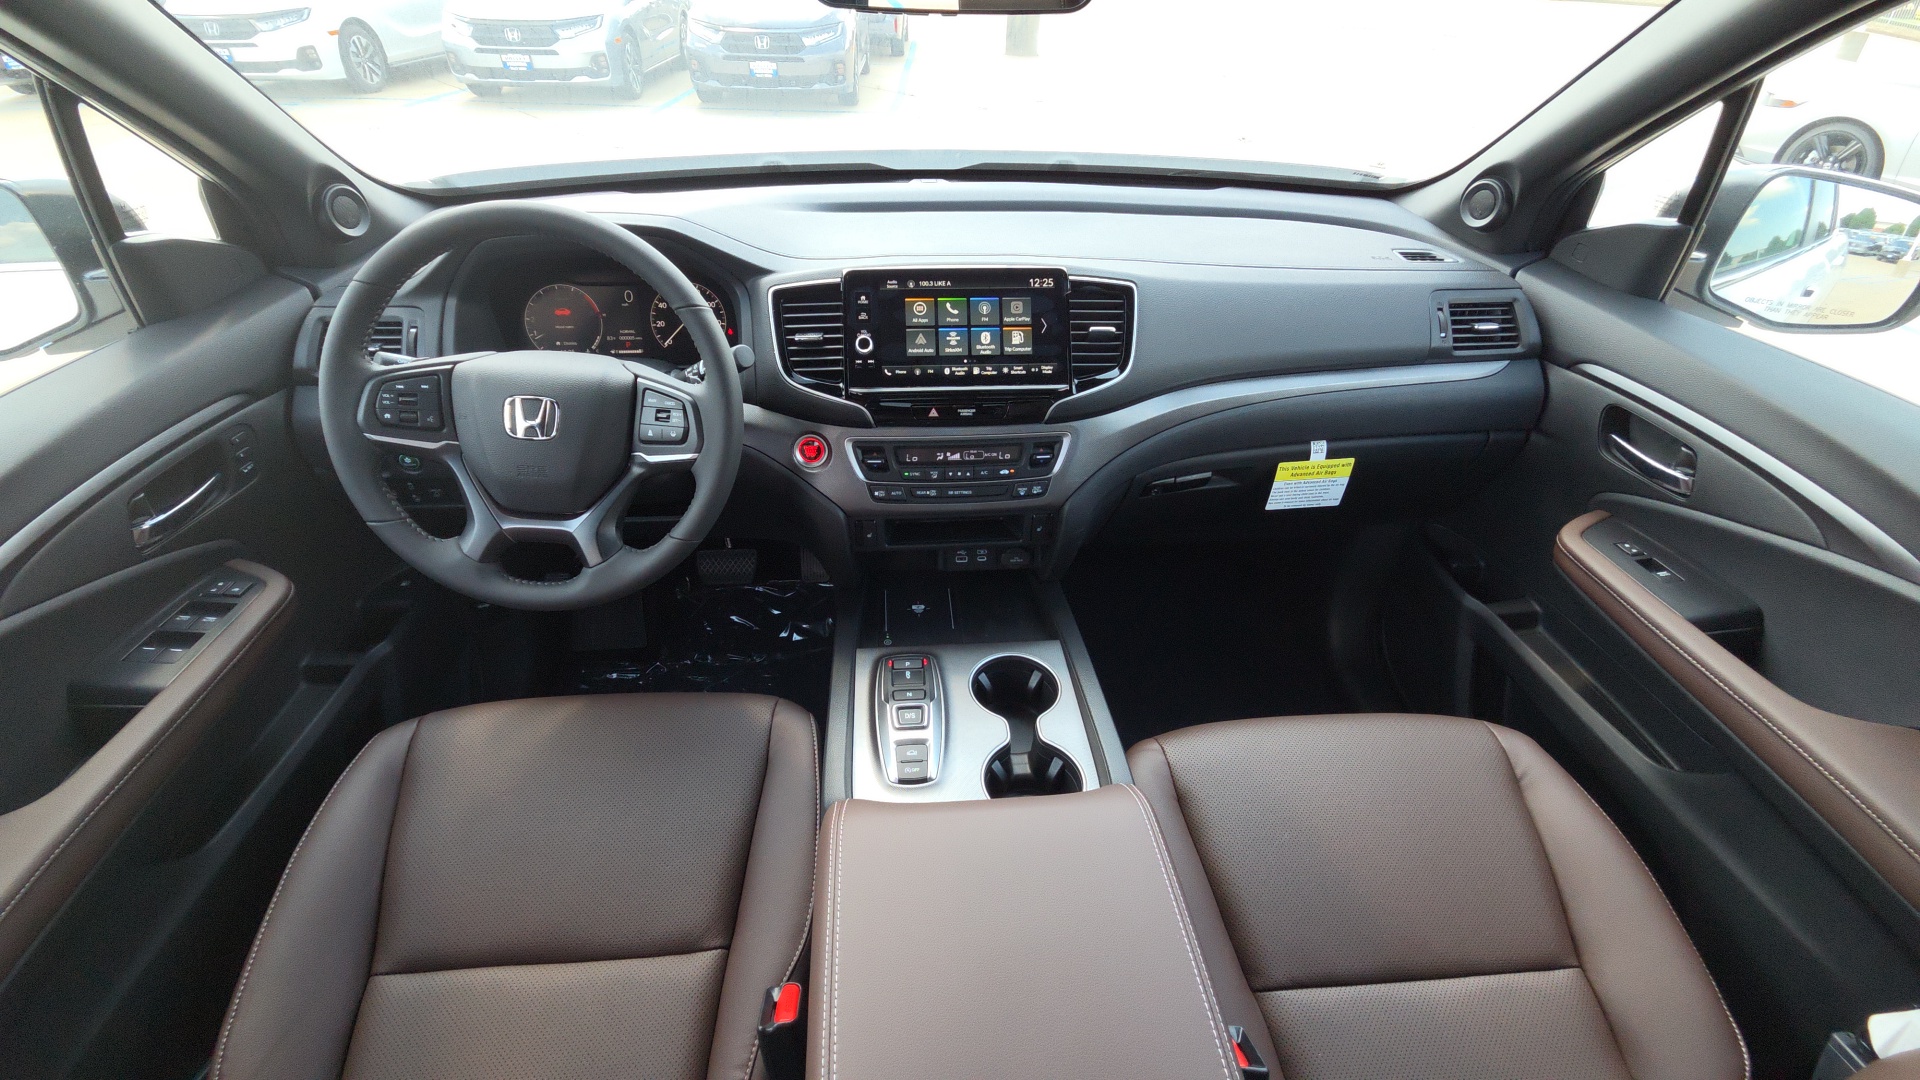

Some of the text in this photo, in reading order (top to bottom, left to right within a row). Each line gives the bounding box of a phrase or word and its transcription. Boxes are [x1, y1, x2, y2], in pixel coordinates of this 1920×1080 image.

[1029, 278, 1054, 287] 12:25
[624, 290, 633, 302] 0
[1744, 296, 1774, 306] OBJECTS
[1830, 309, 1855, 317] CLOSER
